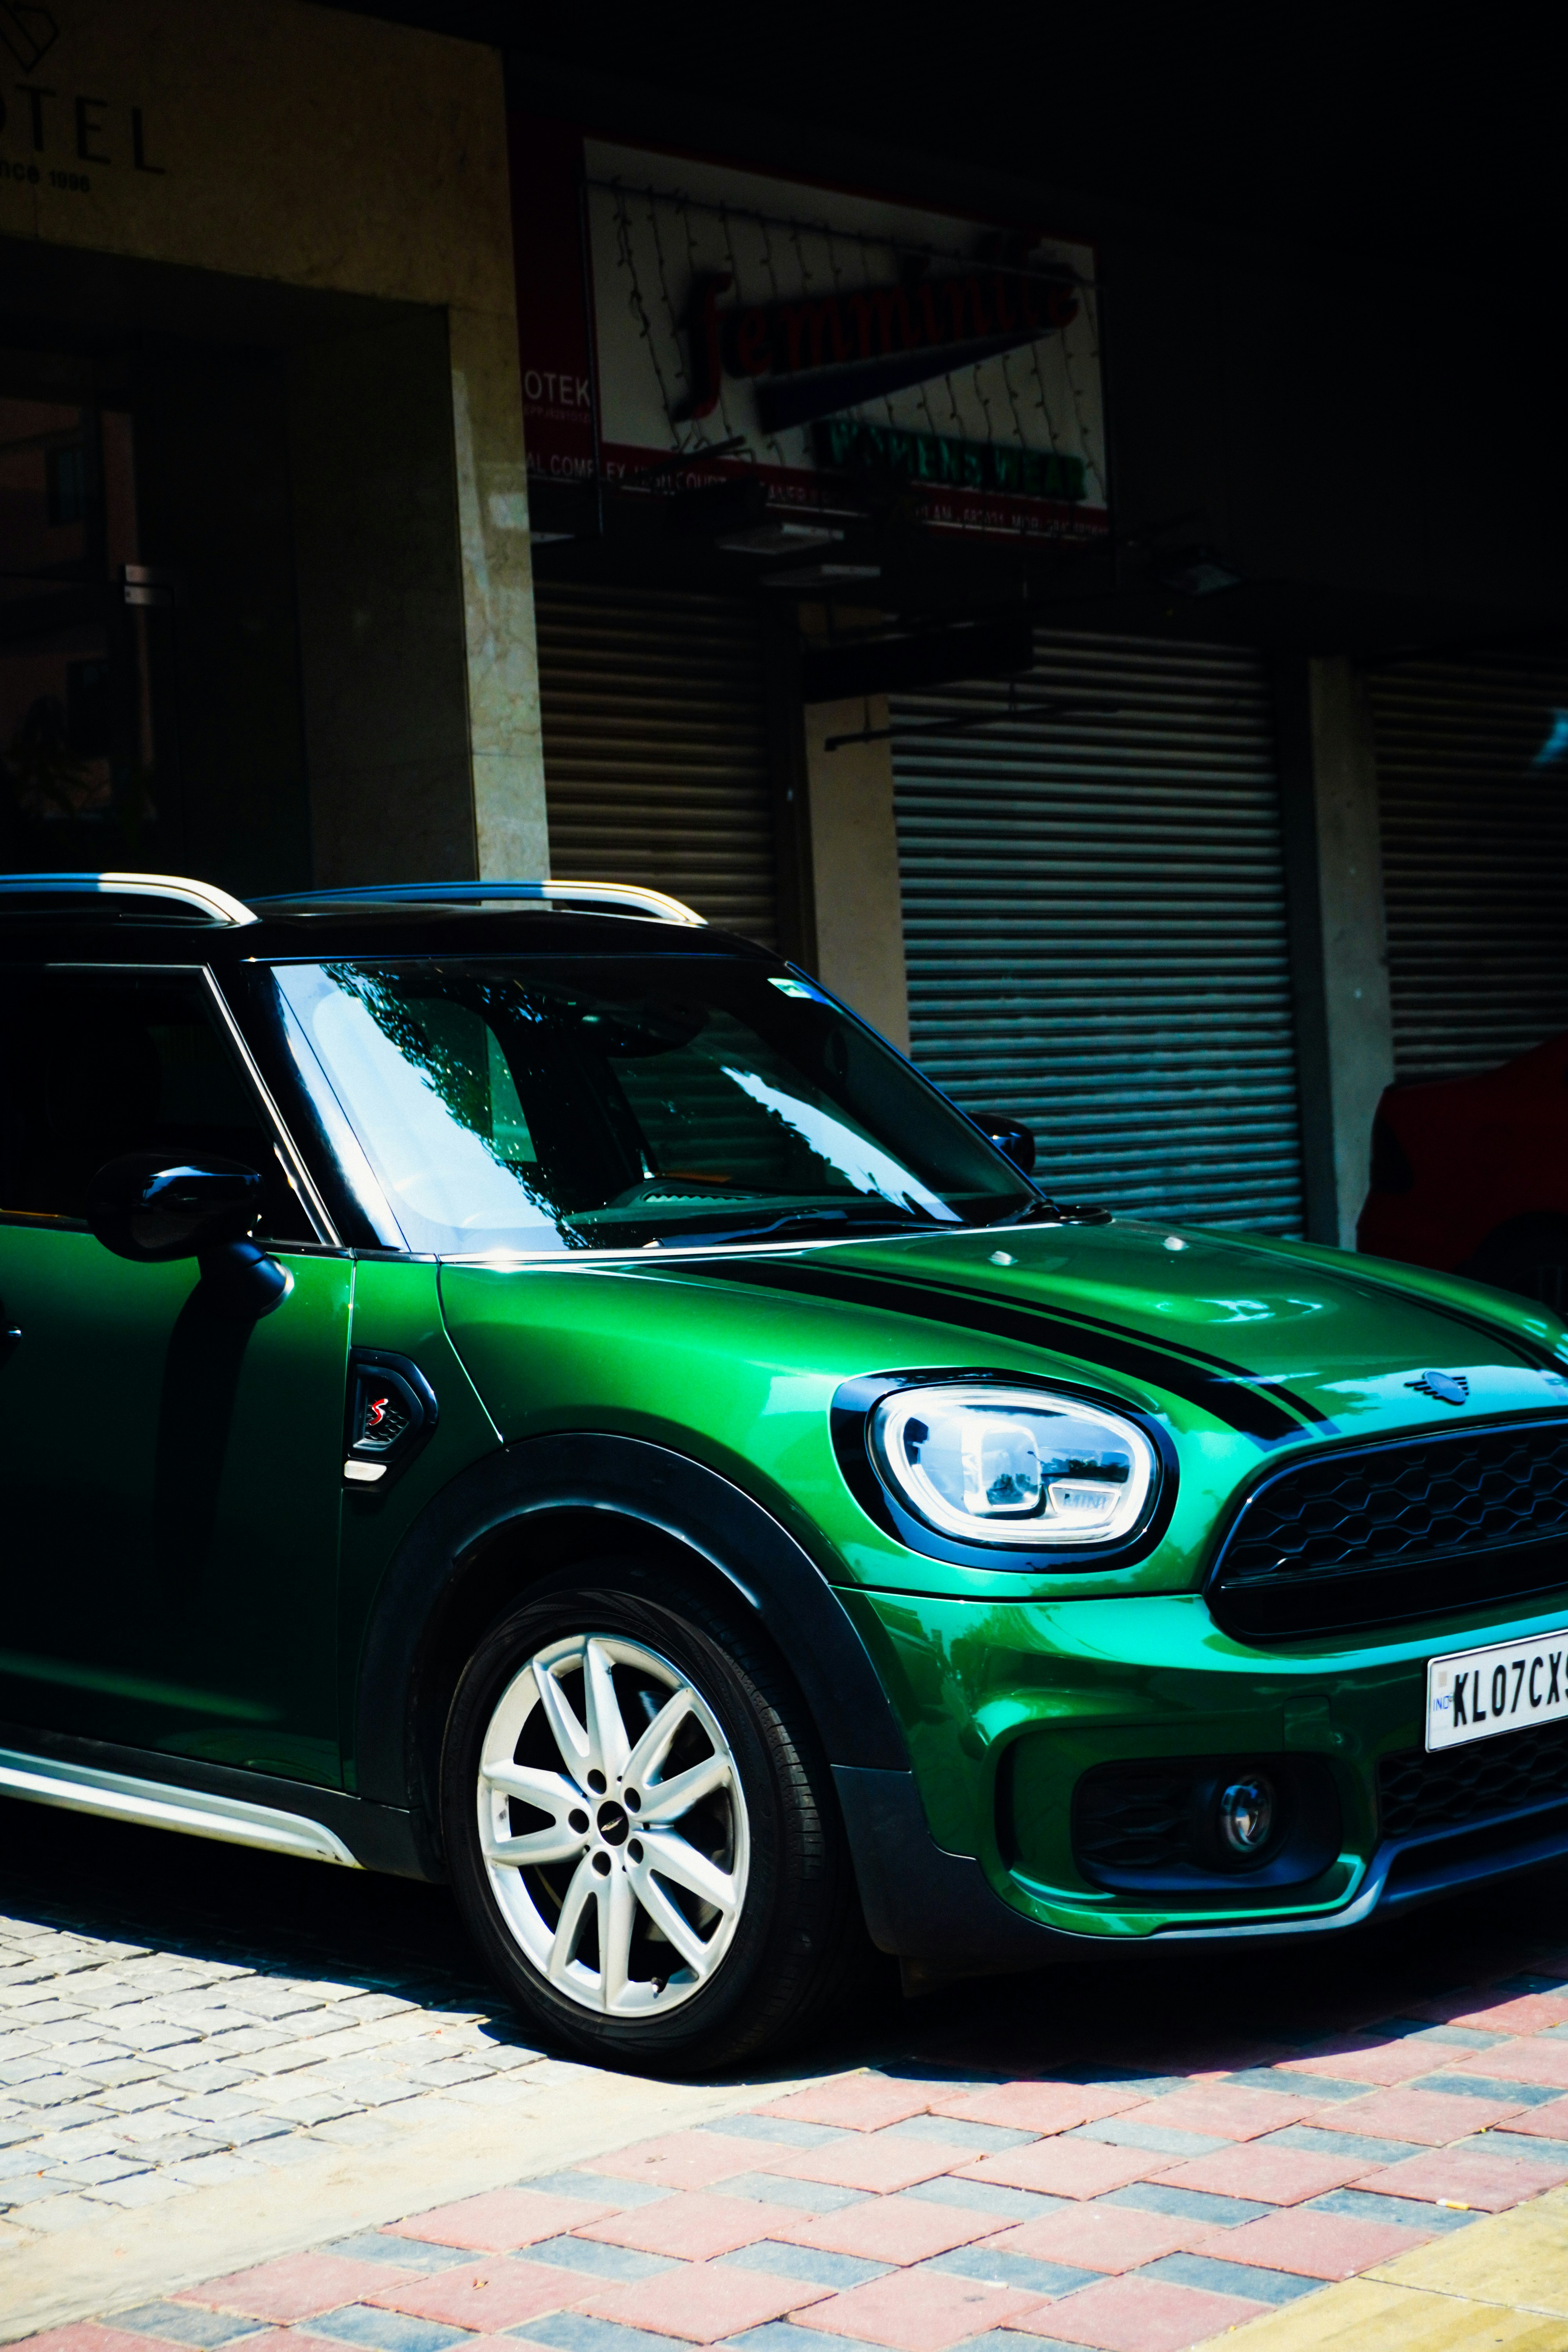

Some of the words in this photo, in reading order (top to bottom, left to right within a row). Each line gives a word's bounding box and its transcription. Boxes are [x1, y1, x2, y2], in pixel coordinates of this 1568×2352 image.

[0, 83, 165, 174] TEL
[1063, 1493, 1106, 1510] MINI
[1433, 1696, 1449, 1711] IND
[1453, 1651, 1568, 1727] KL07CX
